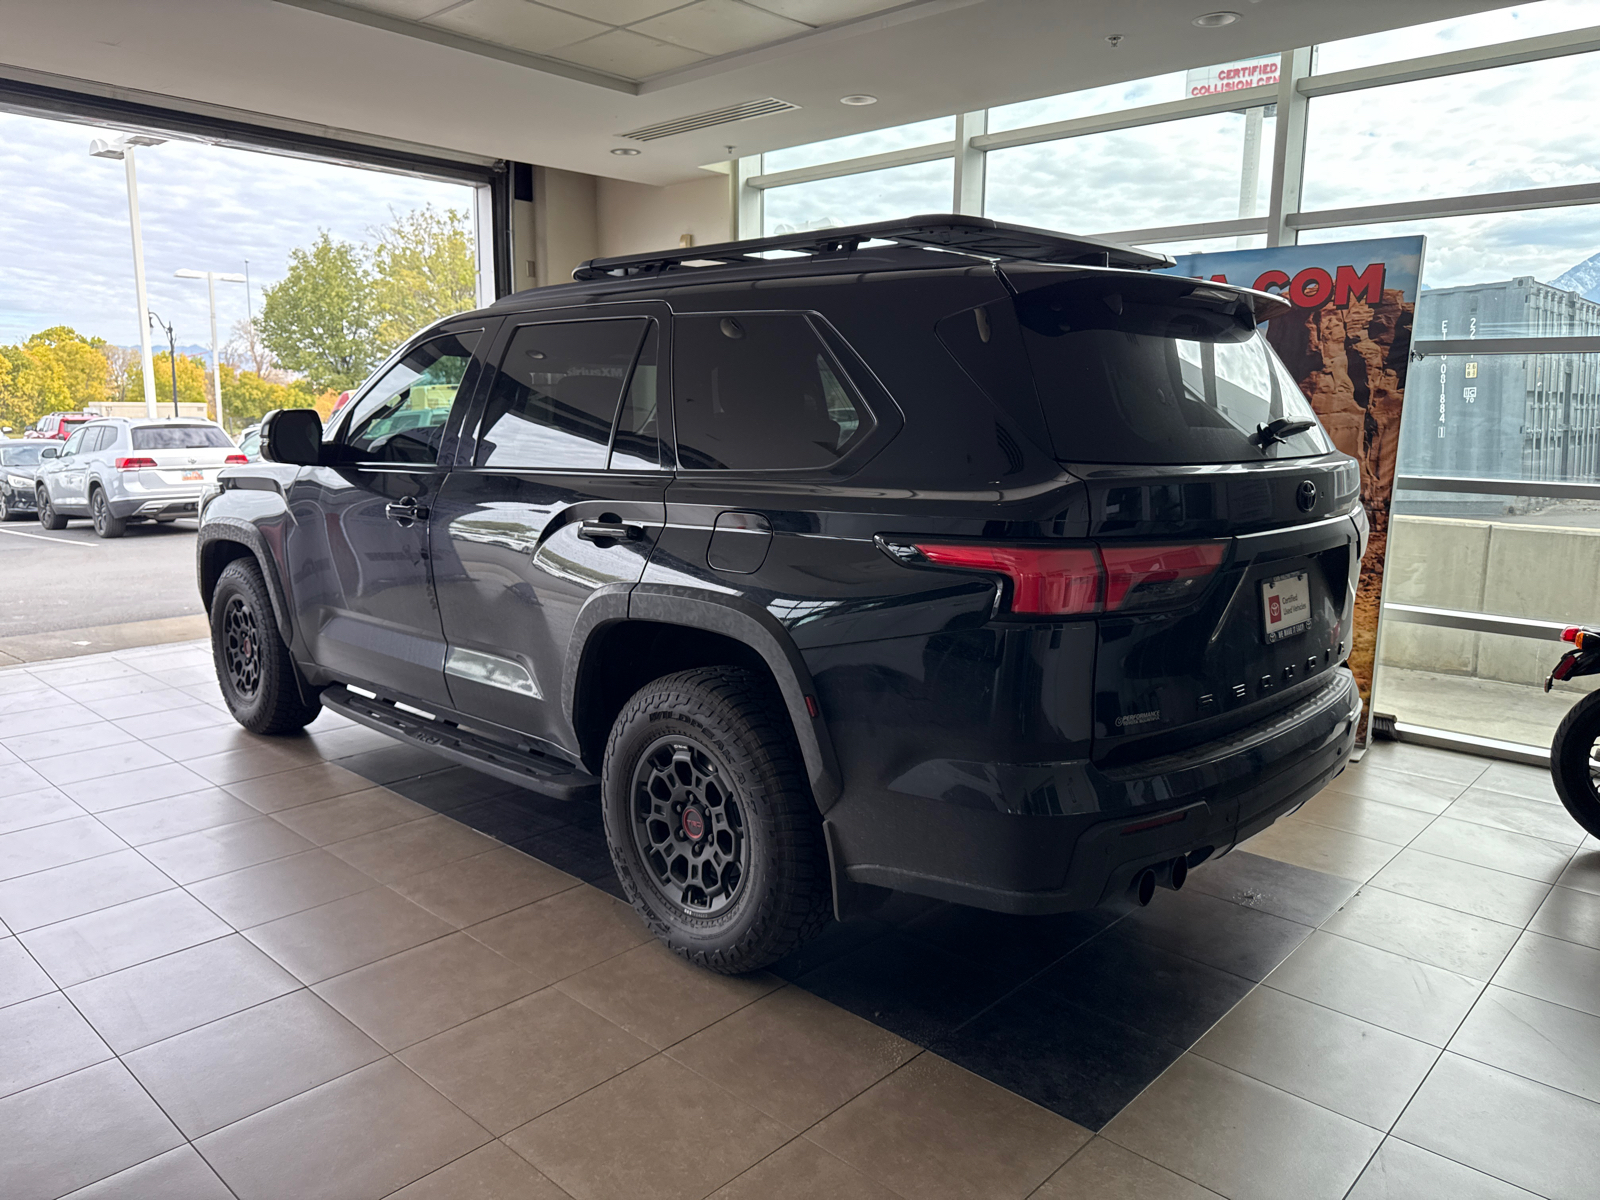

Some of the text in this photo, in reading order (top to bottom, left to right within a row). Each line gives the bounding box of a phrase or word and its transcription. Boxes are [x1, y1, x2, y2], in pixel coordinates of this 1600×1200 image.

[1218, 63, 1278, 80] CERTIFIED
[1191, 79, 1253, 96] COLLISION
[1191, 263, 1386, 309] COM
[1282, 593, 1298, 604] Certified
[1283, 603, 1306, 616] Used Vehicles
[1198, 641, 1345, 706] SEQUOIA
[1122, 710, 1160, 721] PERFORMANCE
[649, 711, 736, 764] WILDPEAK
[687, 819, 702, 828] TRD
